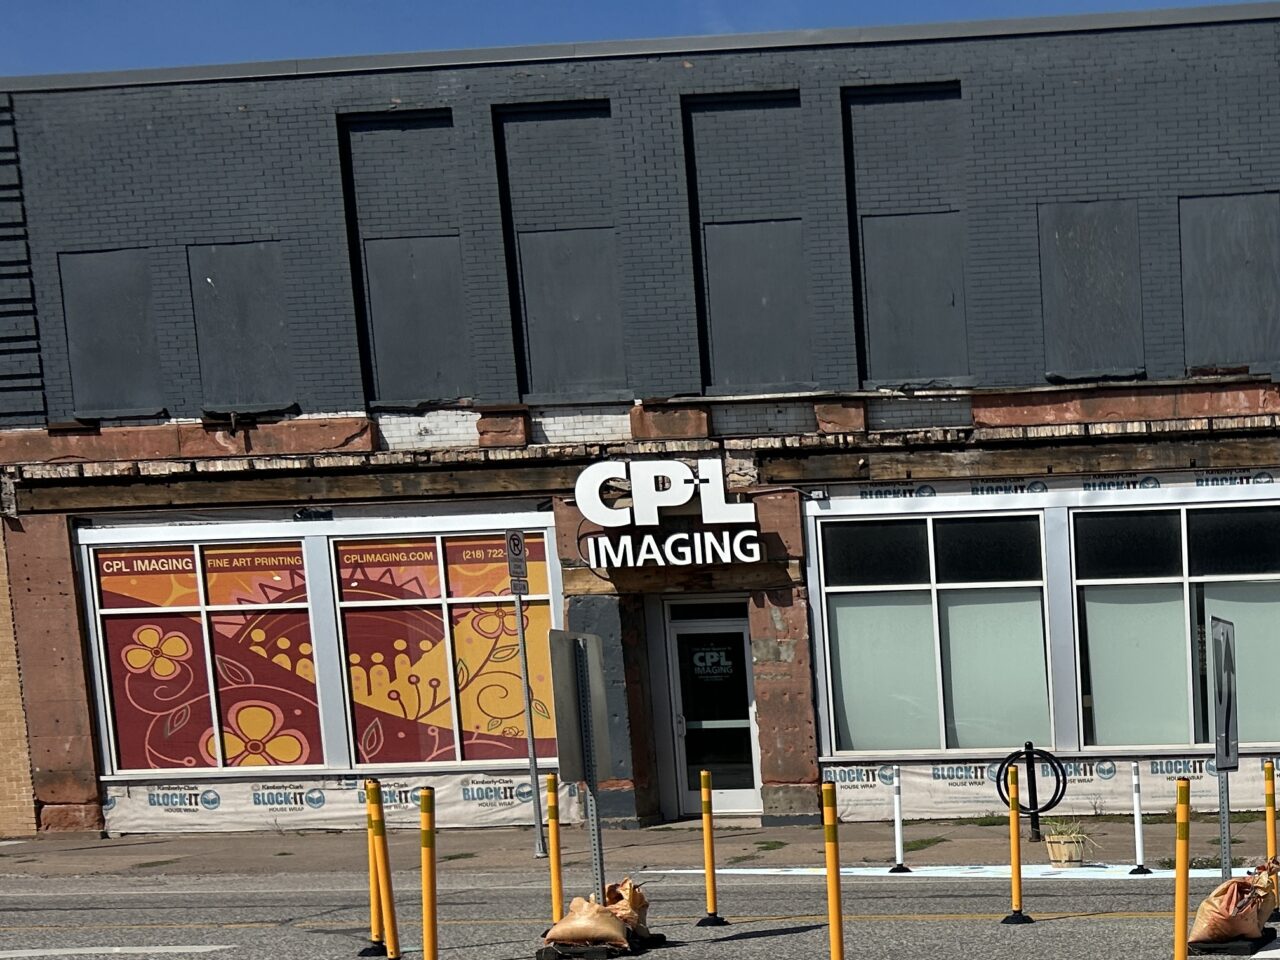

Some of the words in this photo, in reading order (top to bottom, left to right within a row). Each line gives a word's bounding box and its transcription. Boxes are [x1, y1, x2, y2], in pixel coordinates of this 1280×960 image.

[575, 458, 756, 527] CPL
[462, 549, 485, 560] (218)
[587, 530, 761, 568] IMAGING
[207, 559, 230, 568] FINE
[232, 557, 252, 567] ART
[254, 556, 302, 566] PRINTING
[344, 552, 433, 563] CPLIMAGING.COM
[102, 560, 130, 573] CPL
[133, 558, 193, 572] IMAGING
[693, 651, 732, 667] CPL
[694, 666, 733, 674] IMAGING
